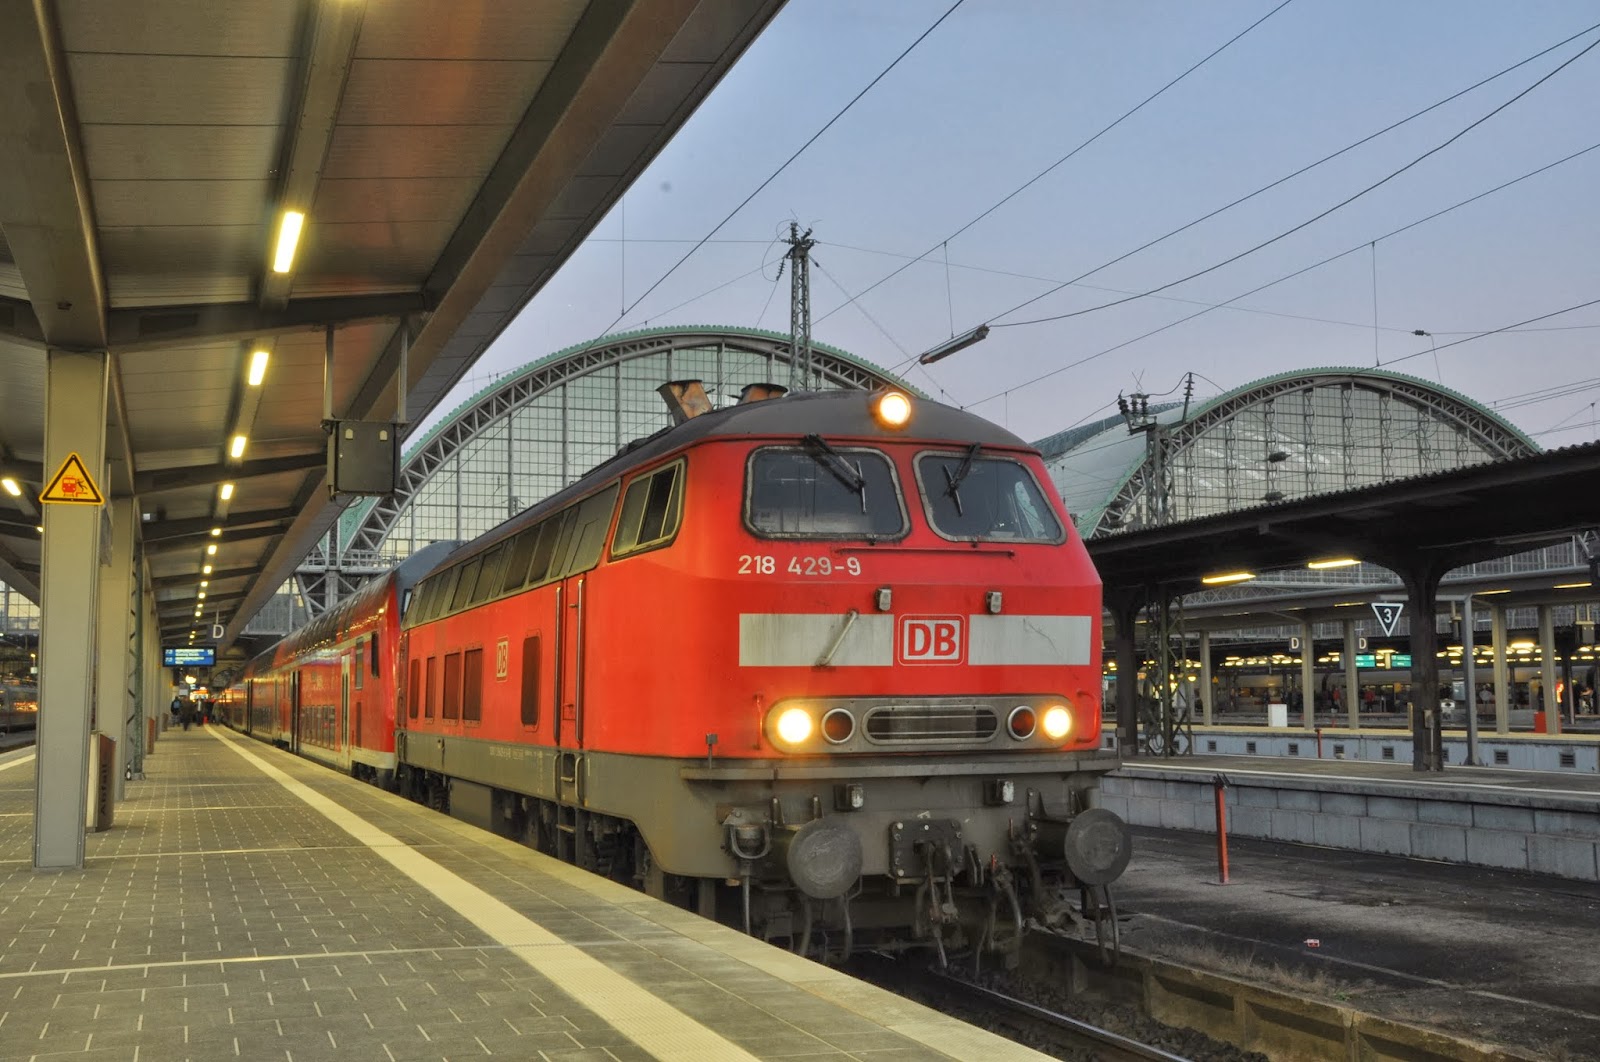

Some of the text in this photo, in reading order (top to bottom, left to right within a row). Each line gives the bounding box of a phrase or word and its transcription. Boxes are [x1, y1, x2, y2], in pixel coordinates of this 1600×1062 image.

[738, 555, 862, 576] 218 429-9
[1383, 608, 1392, 623] 3
[212, 624, 225, 639] D
[907, 623, 957, 657] DB
[1291, 637, 1300, 650] D
[1358, 637, 1367, 650] D
[497, 644, 508, 674] DB
